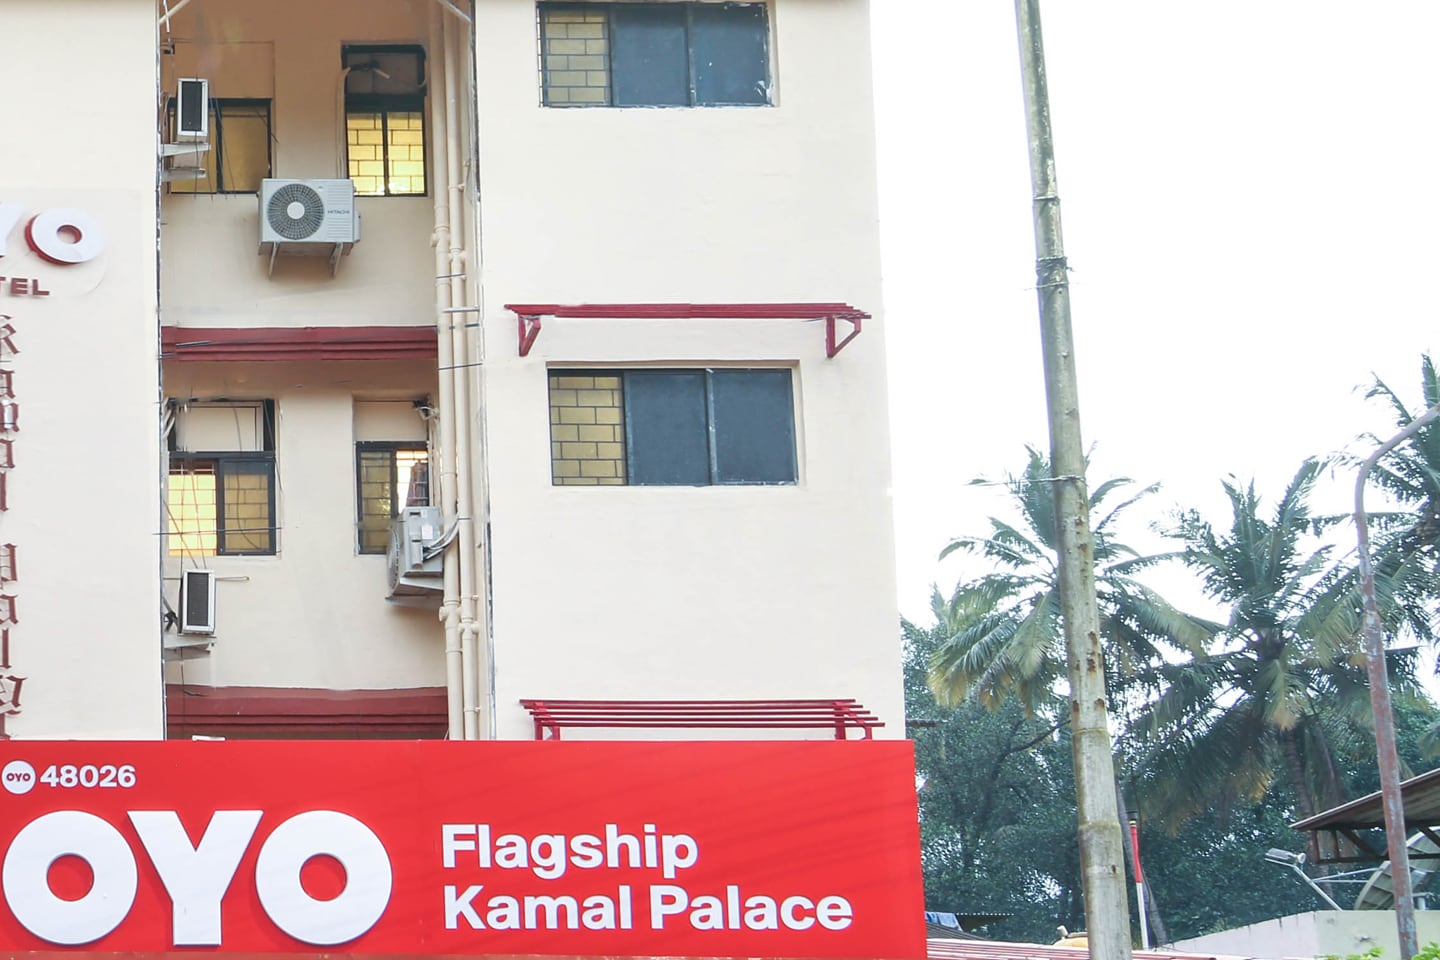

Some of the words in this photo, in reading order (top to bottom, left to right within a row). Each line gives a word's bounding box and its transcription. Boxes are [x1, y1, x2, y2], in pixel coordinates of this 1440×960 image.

[6, 772, 31, 783] OYO
[40, 765, 136, 788] 48026
[441, 823, 699, 879] Flagship
[2, 810, 393, 946] OYO
[443, 884, 633, 930] Kamal
[649, 884, 854, 930] Palace
